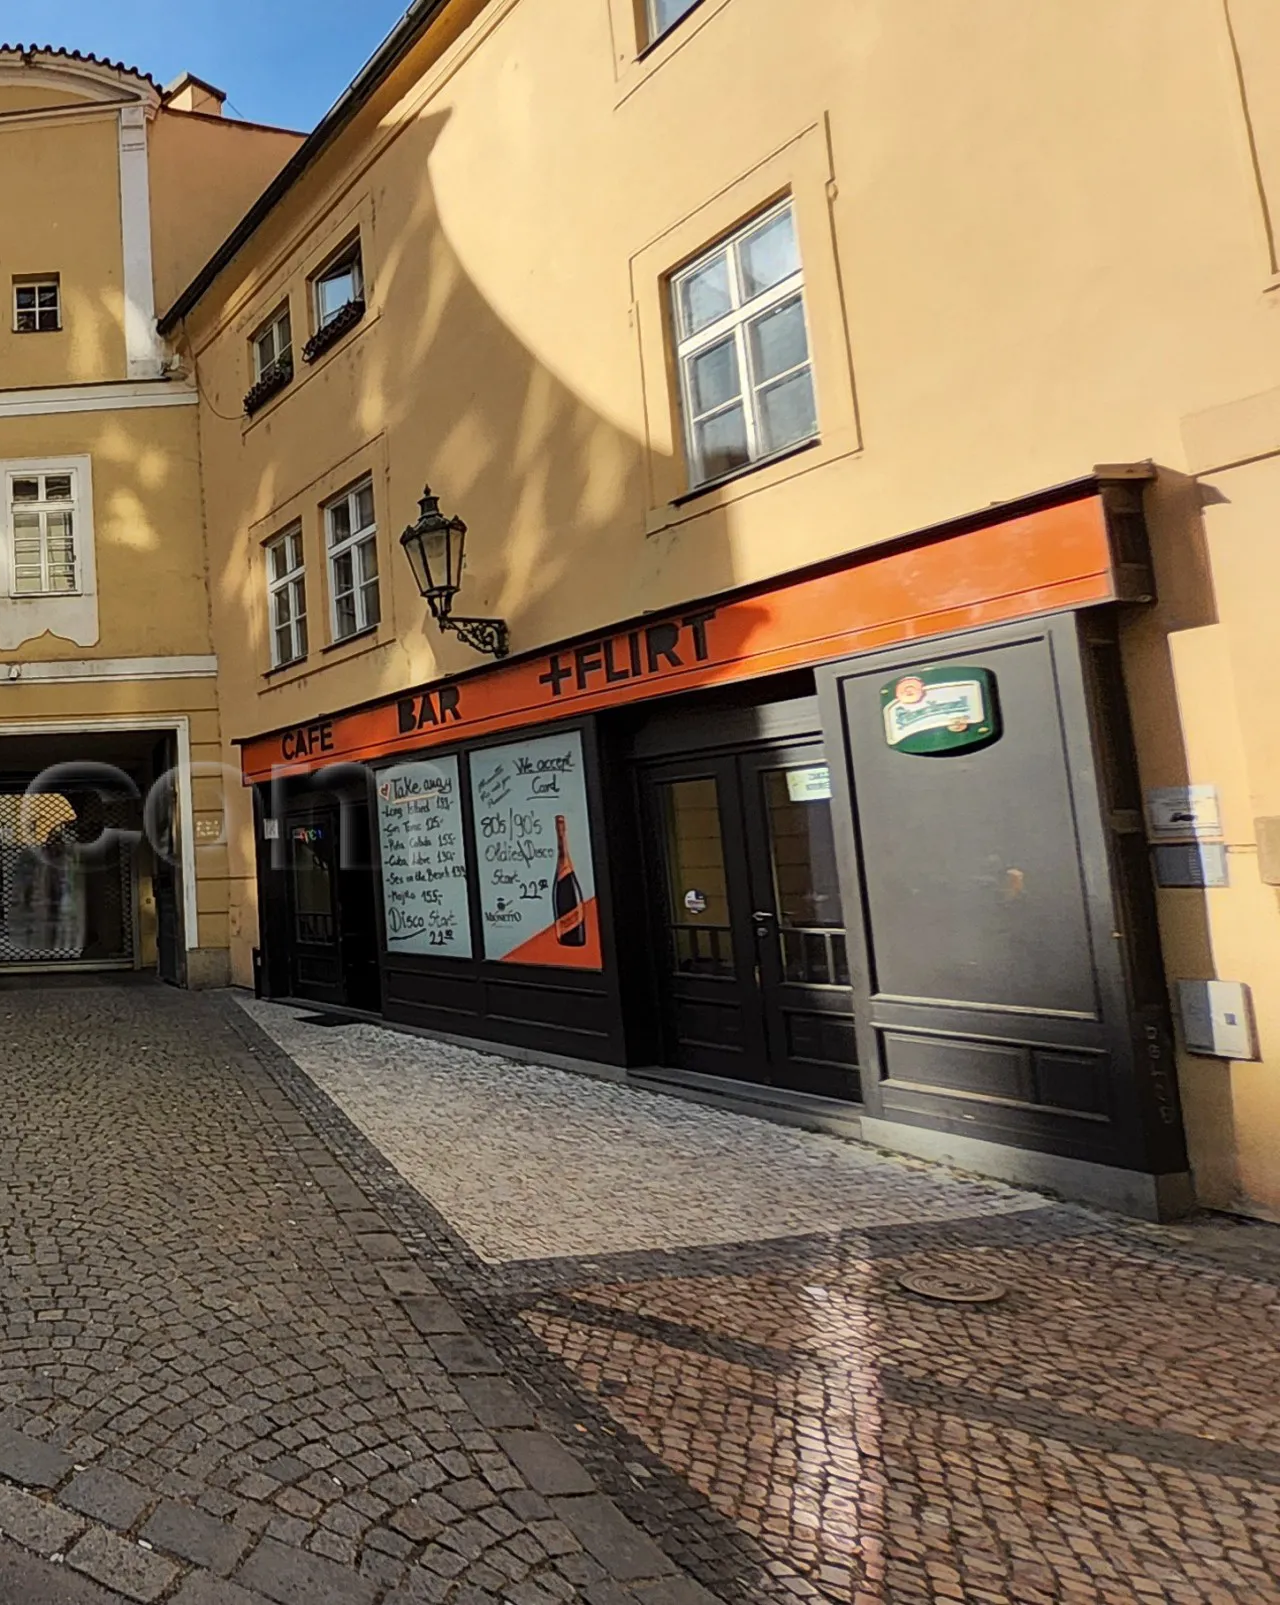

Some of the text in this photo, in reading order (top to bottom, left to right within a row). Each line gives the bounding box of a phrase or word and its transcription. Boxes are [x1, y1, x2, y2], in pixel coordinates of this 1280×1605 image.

[281, 721, 334, 760] CAFE
[396, 687, 462, 734] BAR
[513, 757, 533, 774] We
[391, 777, 421, 799] Take
[532, 774, 560, 794] Card
[388, 907, 424, 933] Disco
